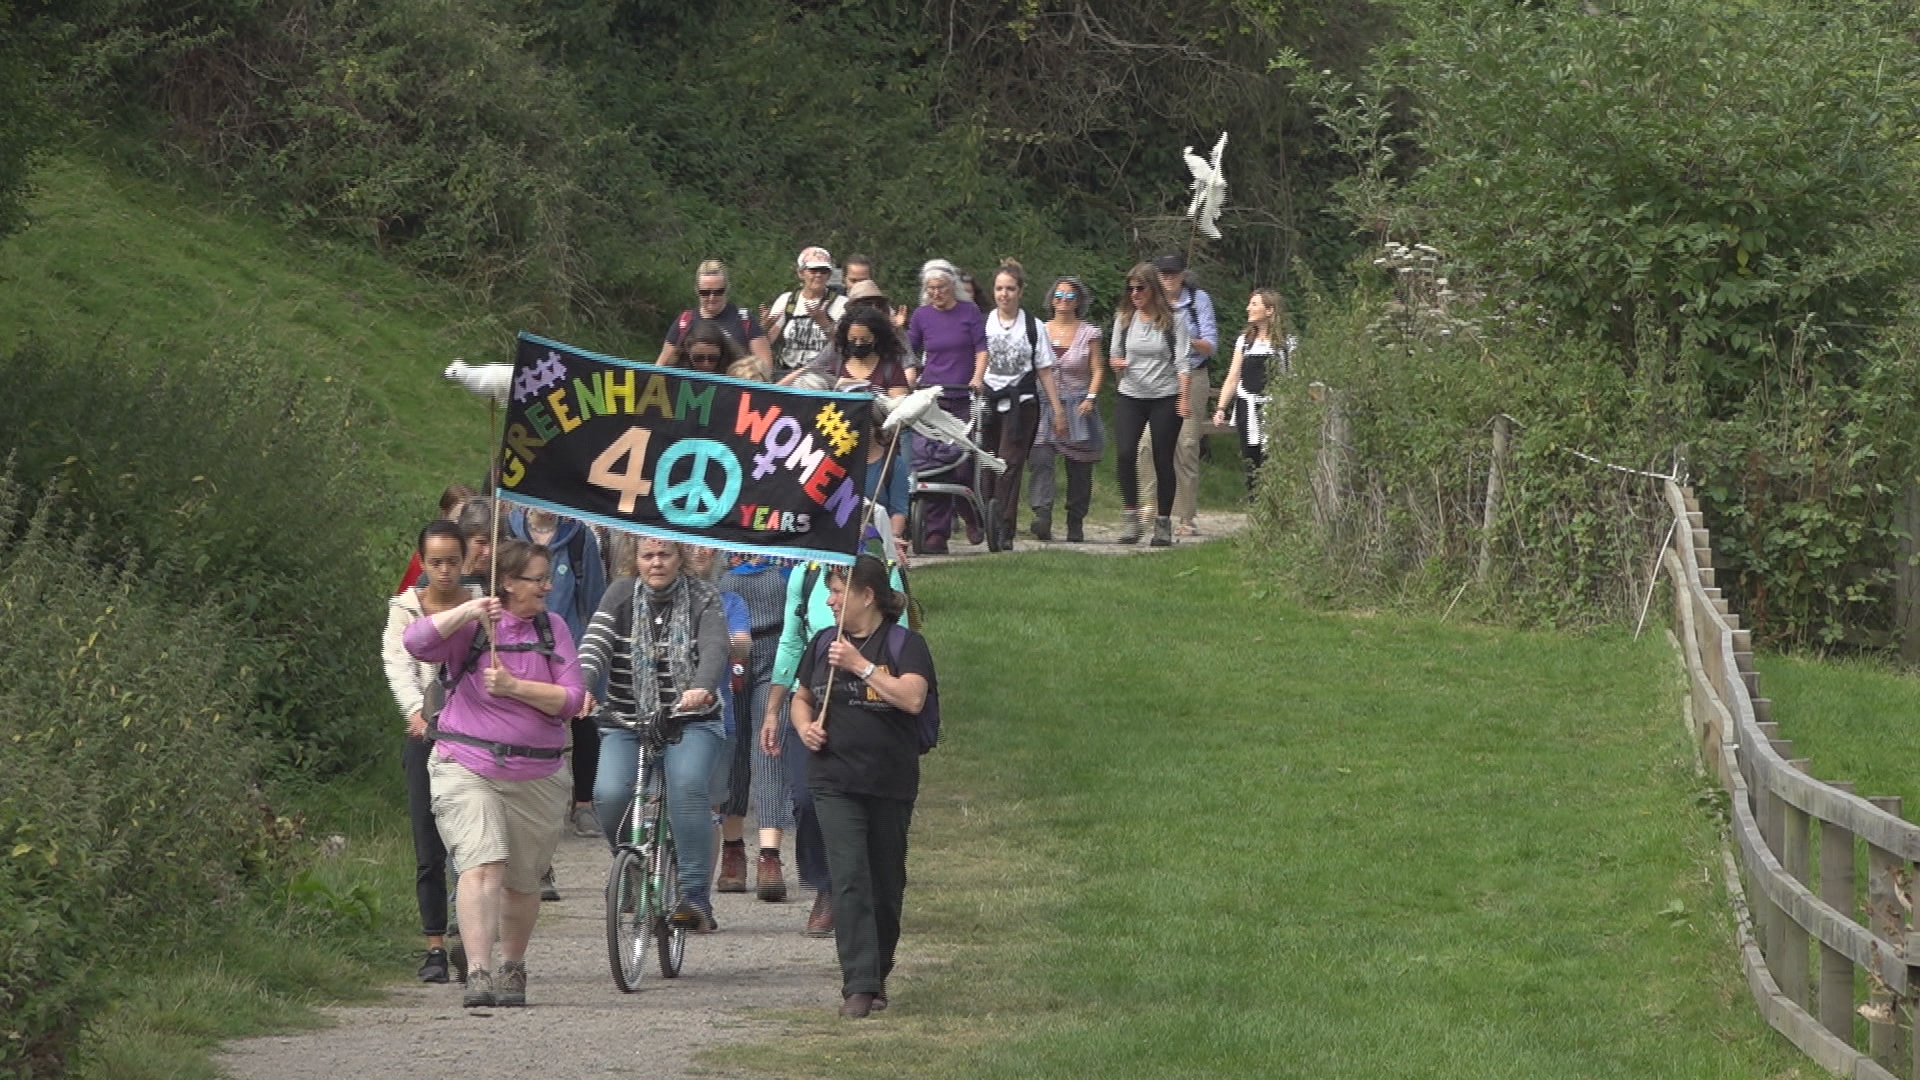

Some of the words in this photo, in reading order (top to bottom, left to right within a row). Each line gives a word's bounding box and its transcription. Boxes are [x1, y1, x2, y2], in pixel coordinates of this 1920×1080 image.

[502, 370, 716, 488] GREENHAM
[735, 391, 860, 528] WOMEN
[739, 504, 811, 533] YEARS
